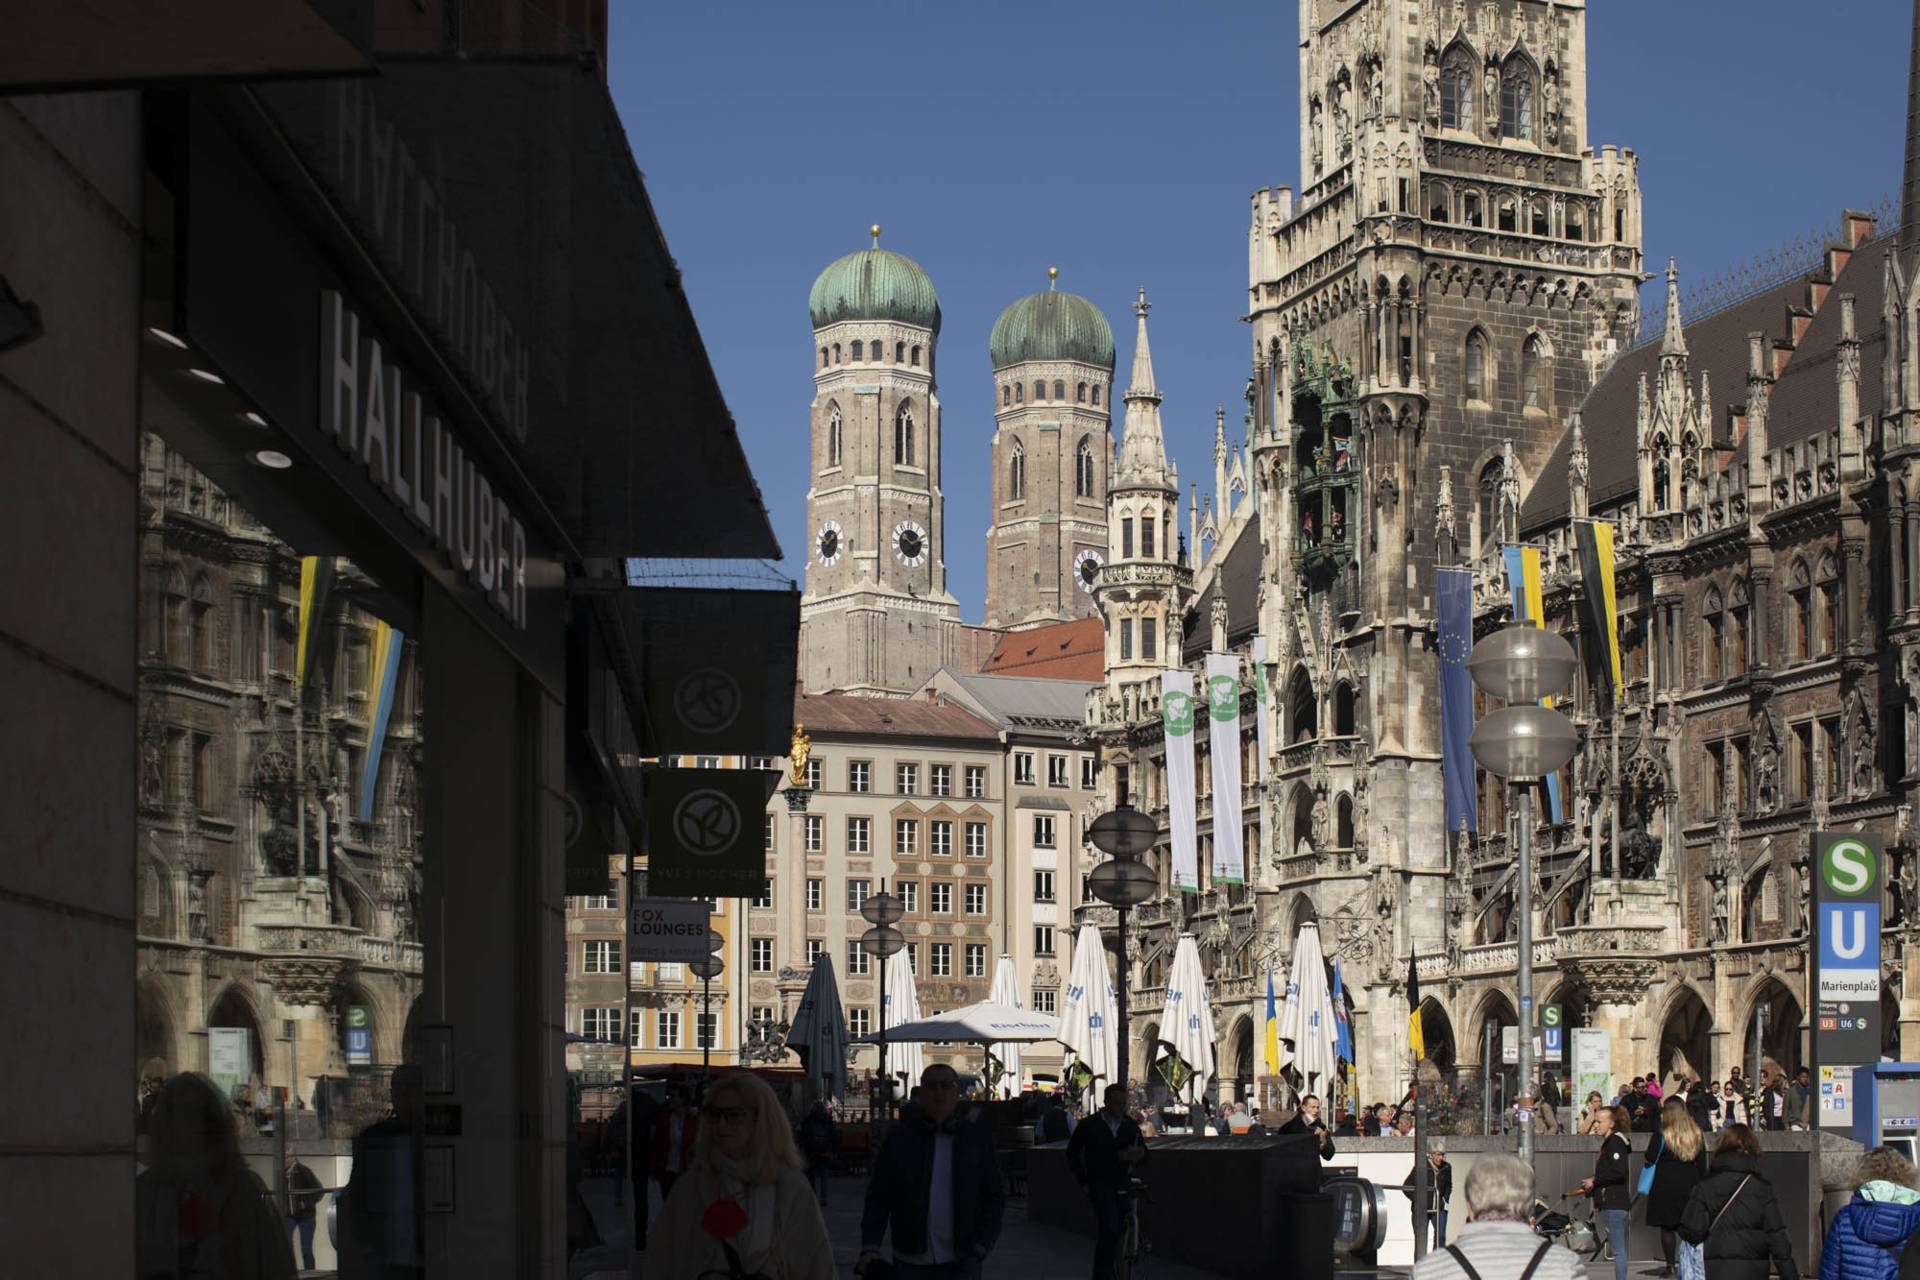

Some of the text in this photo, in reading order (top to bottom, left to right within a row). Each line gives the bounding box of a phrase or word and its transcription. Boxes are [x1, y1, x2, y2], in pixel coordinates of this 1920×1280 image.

[320, 289, 526, 631] HALLHUBER
[1832, 842, 1868, 892] S
[633, 909, 664, 922] FOX
[633, 923, 704, 936] LOUNGES
[1831, 910, 1865, 959] U
[1545, 1007, 1558, 1025] S
[1822, 1019, 1867, 1029] U3 U6 S
[1546, 1030, 1557, 1047] U
